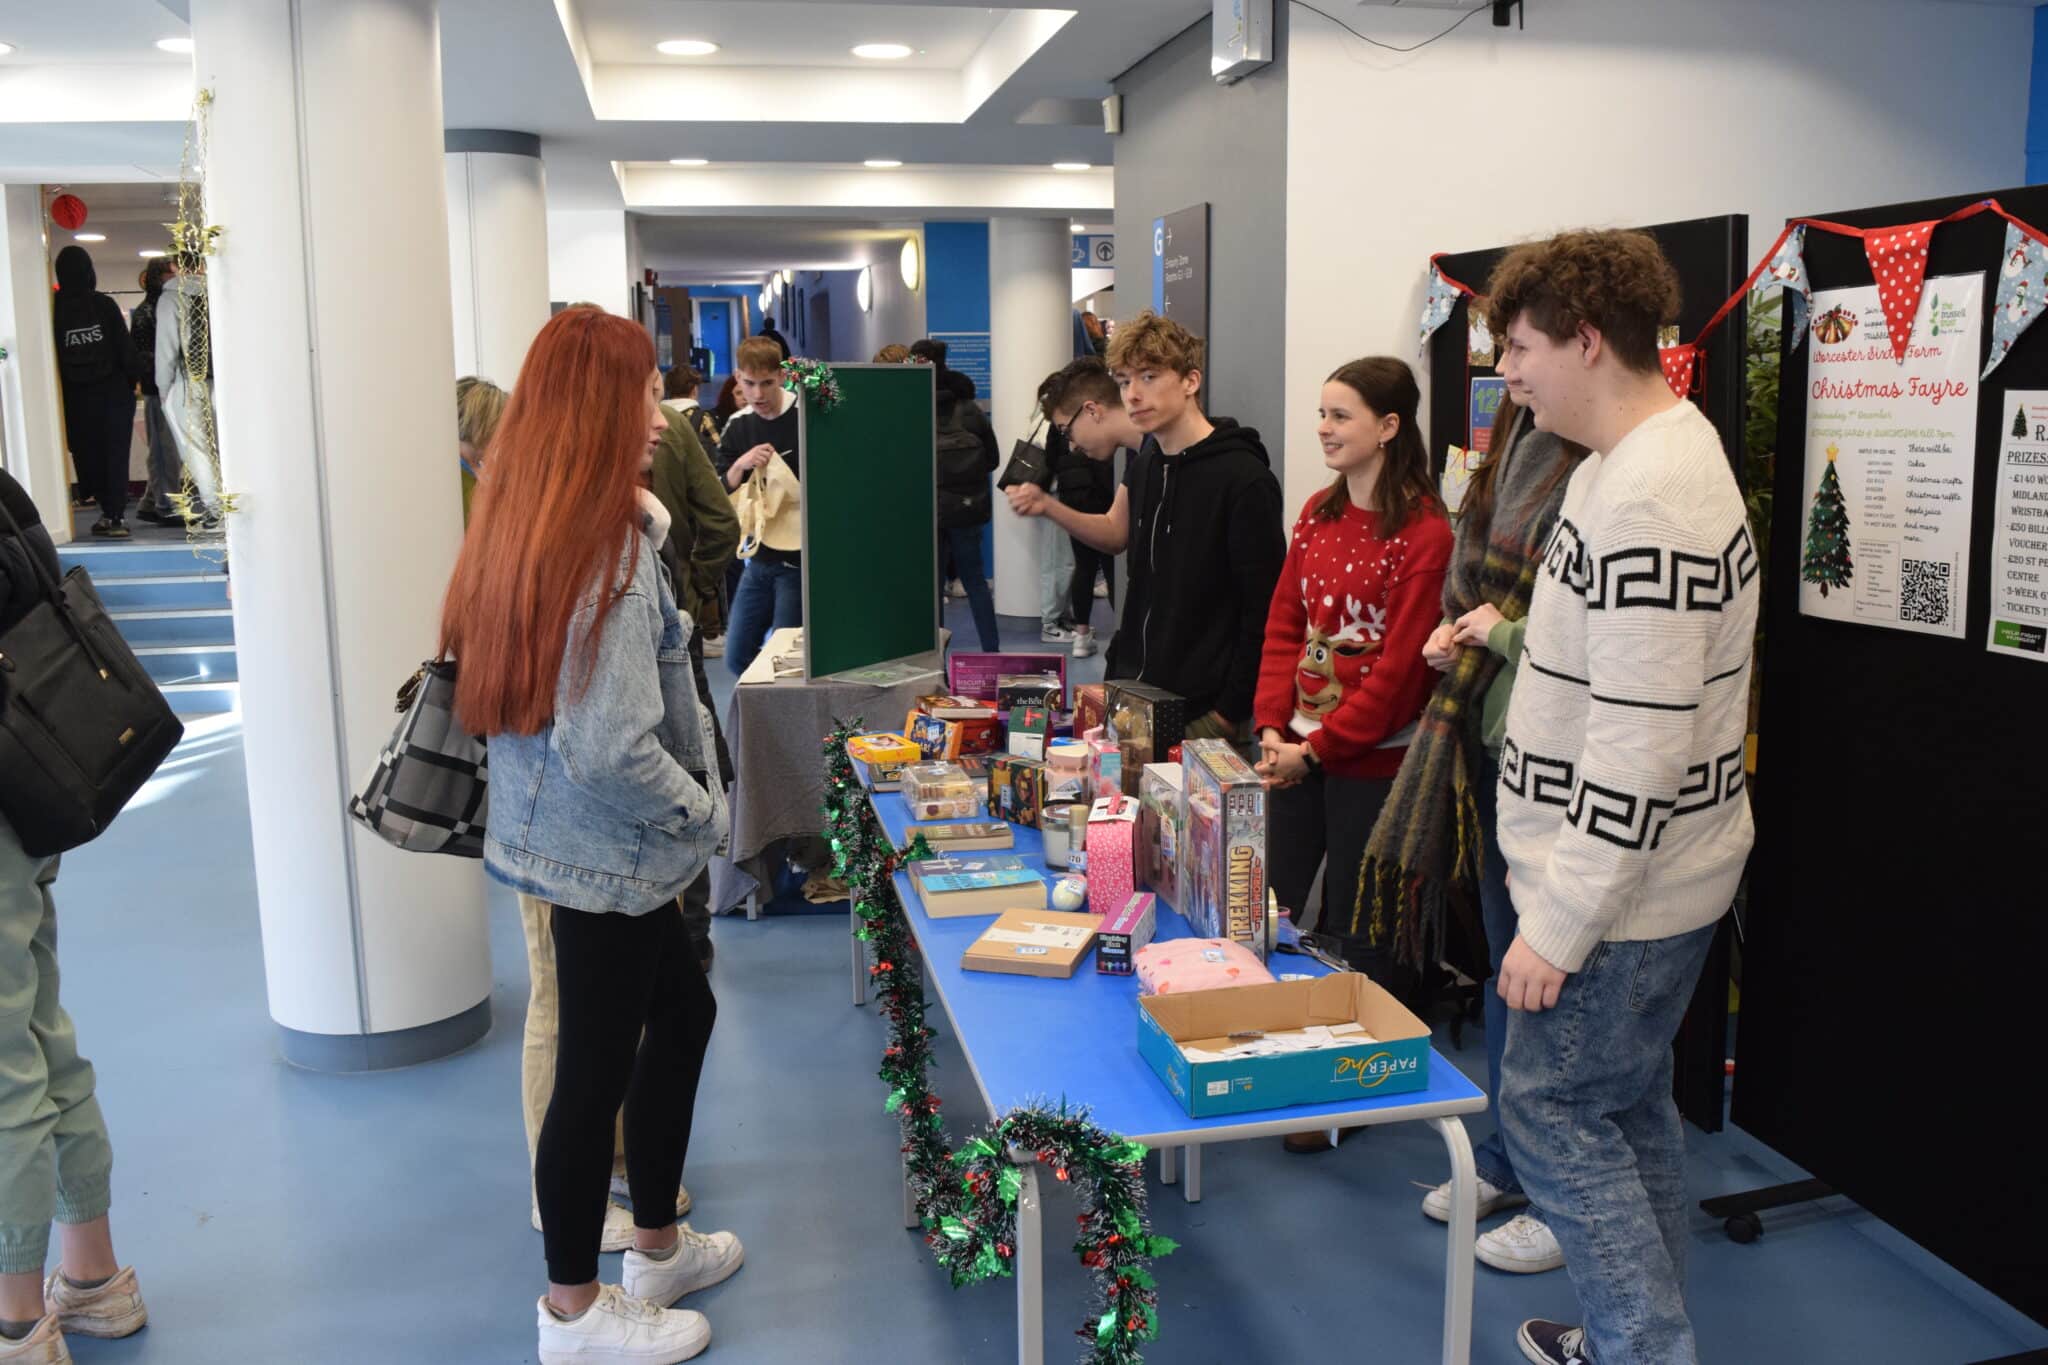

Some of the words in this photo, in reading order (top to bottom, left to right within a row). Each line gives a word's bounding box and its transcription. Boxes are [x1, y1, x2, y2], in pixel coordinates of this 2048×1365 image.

[1154, 227, 1164, 257] G
[1813, 349, 1866, 363] Worcester
[1867, 347, 1896, 362] Sixt
[1907, 344, 1943, 359] Form
[1812, 376, 1904, 400] Christmas
[1908, 376, 1969, 406] Fayre
[1907, 475, 1940, 484] Christmas
[1906, 490, 1940, 500] Christmas
[2007, 570, 2040, 583] CENTRE
[2006, 602, 2041, 616] TICKETS
[1229, 845, 1254, 942] TREKKING
[1369, 1057, 1417, 1074] PAPER
